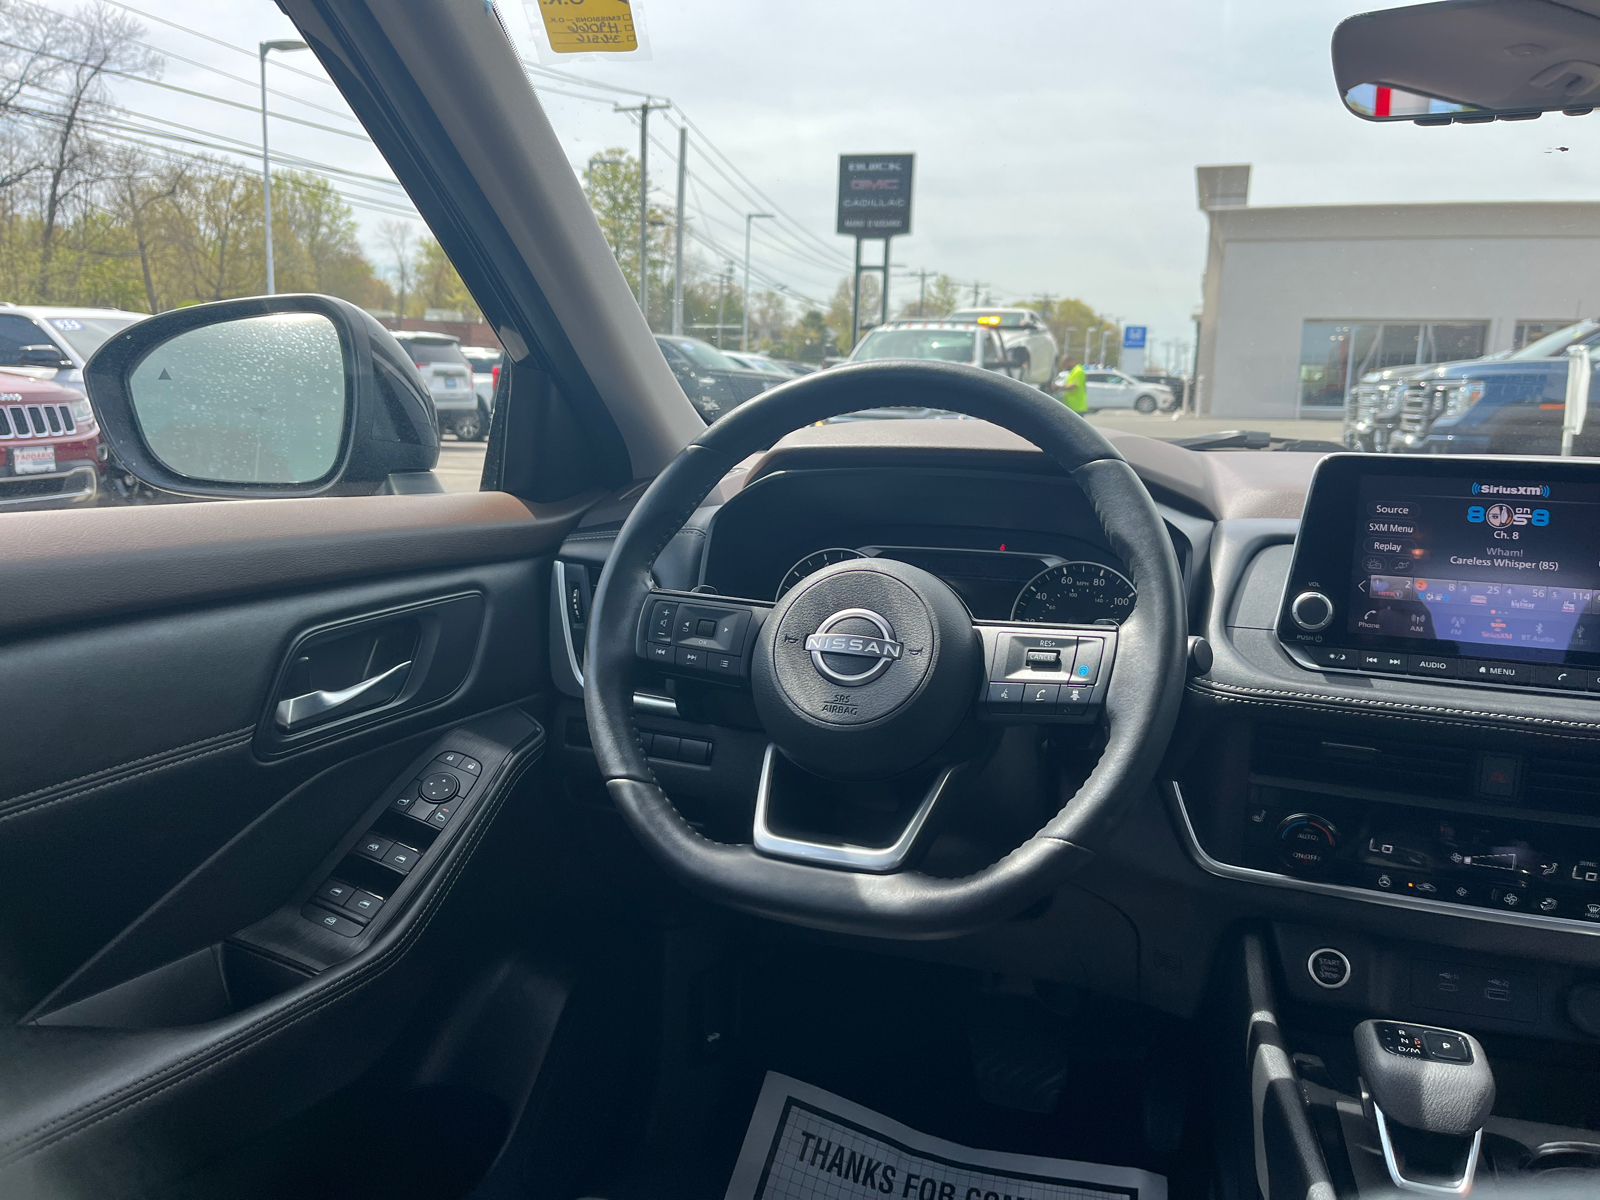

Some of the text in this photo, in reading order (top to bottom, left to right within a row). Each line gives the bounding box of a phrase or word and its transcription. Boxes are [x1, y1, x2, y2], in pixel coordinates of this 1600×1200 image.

[848, 163, 902, 171] BUICK
[850, 179, 899, 190] GMC
[843, 199, 906, 207] CADILLAC
[1376, 504, 1409, 515] Source
[1369, 523, 1414, 533] SXM Menu
[1493, 530, 1519, 540] Ch. 8
[1374, 542, 1402, 552] Replay
[1486, 547, 1524, 557] Wham!
[1450, 556, 1559, 572] Careless Whisper (85)
[1405, 581, 1411, 589] 2
[1448, 583, 1455, 591] 8
[1487, 586, 1500, 594] 25
[1532, 589, 1545, 597] 56
[1572, 592, 1590, 601] 114
[1114, 597, 1129, 606] 100
[1358, 621, 1380, 630] Phone
[1481, 631, 1513, 640] SiriusXM
[1532, 635, 1555, 643] Audio
[807, 638, 901, 657] NISSAN
[1029, 653, 1056, 661] CANCEL
[1419, 661, 1447, 669] AUDIO
[1489, 667, 1516, 676] MENU
[833, 694, 850, 703] SRS
[822, 704, 858, 716] AIRBAG
[1318, 957, 1340, 966] START
[1319, 971, 1339, 979] STOP
[1398, 1045, 1421, 1054] D/M
[798, 1130, 957, 1200] THANKS FOR
